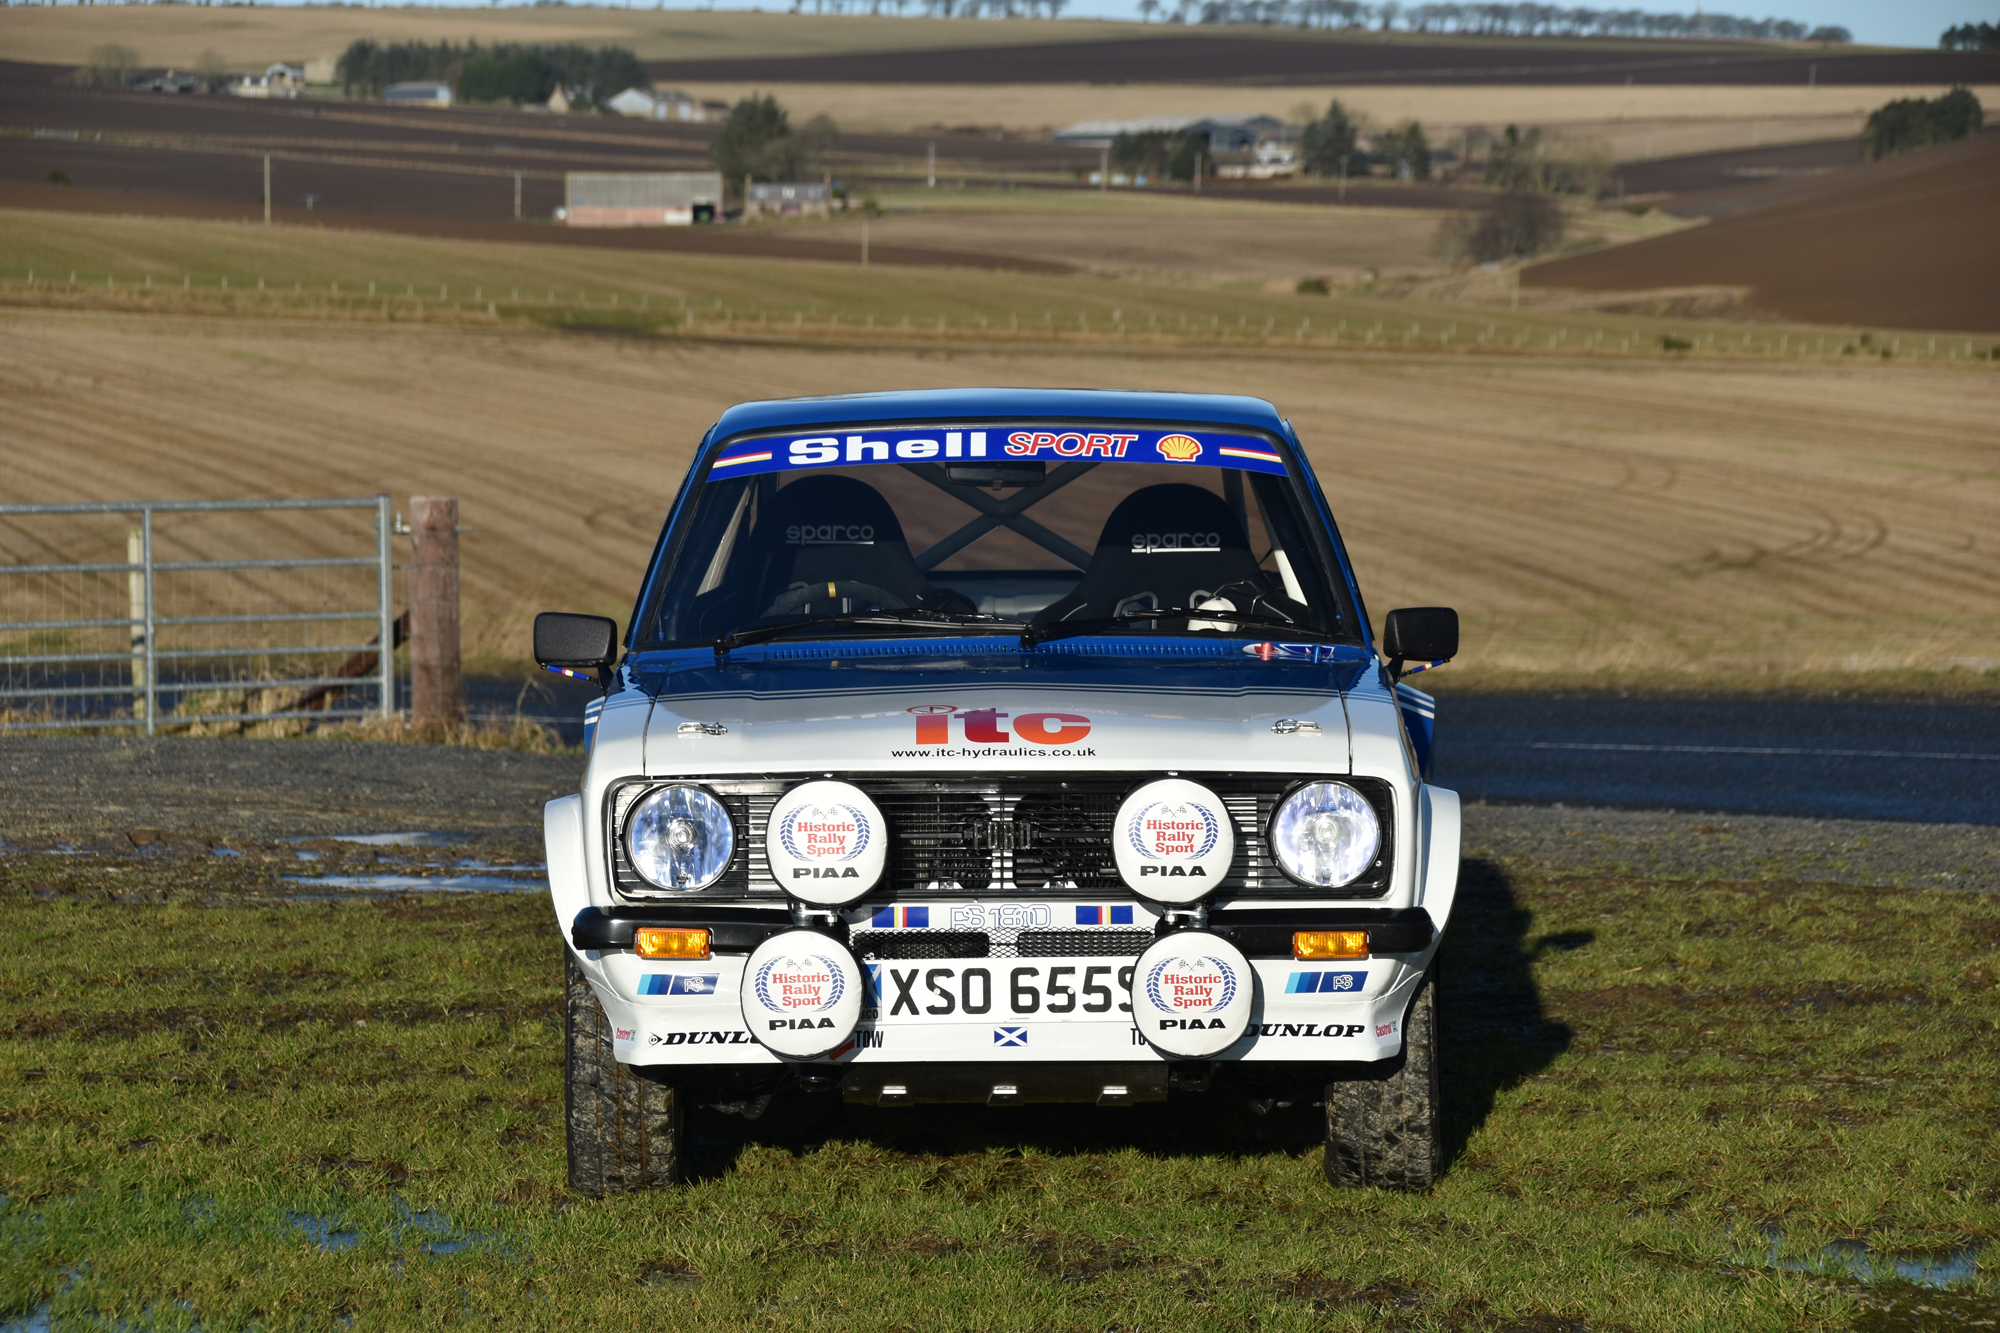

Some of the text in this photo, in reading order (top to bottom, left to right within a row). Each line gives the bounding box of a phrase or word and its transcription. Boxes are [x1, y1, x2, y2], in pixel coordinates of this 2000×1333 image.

[789, 432, 1139, 465] Shell SPORT
[786, 525, 874, 545] sparco
[1131, 533, 1220, 554] sparco
[906, 704, 1092, 745] itc
[891, 747, 1097, 759] www.itc-hydraulics.co.uk
[797, 821, 855, 832] Historic
[1146, 820, 1204, 830] Historic
[807, 833, 846, 846] Rally
[974, 821, 1031, 850] FORD
[1156, 831, 1195, 843] Rally
[807, 845, 847, 857] Sport
[1155, 843, 1195, 855] Sport
[793, 867, 860, 879] PIAA
[1140, 865, 1207, 877] PIAA
[772, 972, 830, 984] Historic
[1164, 974, 1222, 984] Historic
[1333, 974, 1354, 991] RS
[782, 984, 821, 996] Rally
[890, 967, 991, 1015] XSO
[1174, 985, 1213, 997] Rally
[782, 996, 822, 1008] Sport
[1173, 996, 1213, 1009] Sport
[768, 1017, 836, 1031] PIAA
[1159, 1018, 1227, 1030] PIAA
[855, 1030, 884, 1048] TOW
